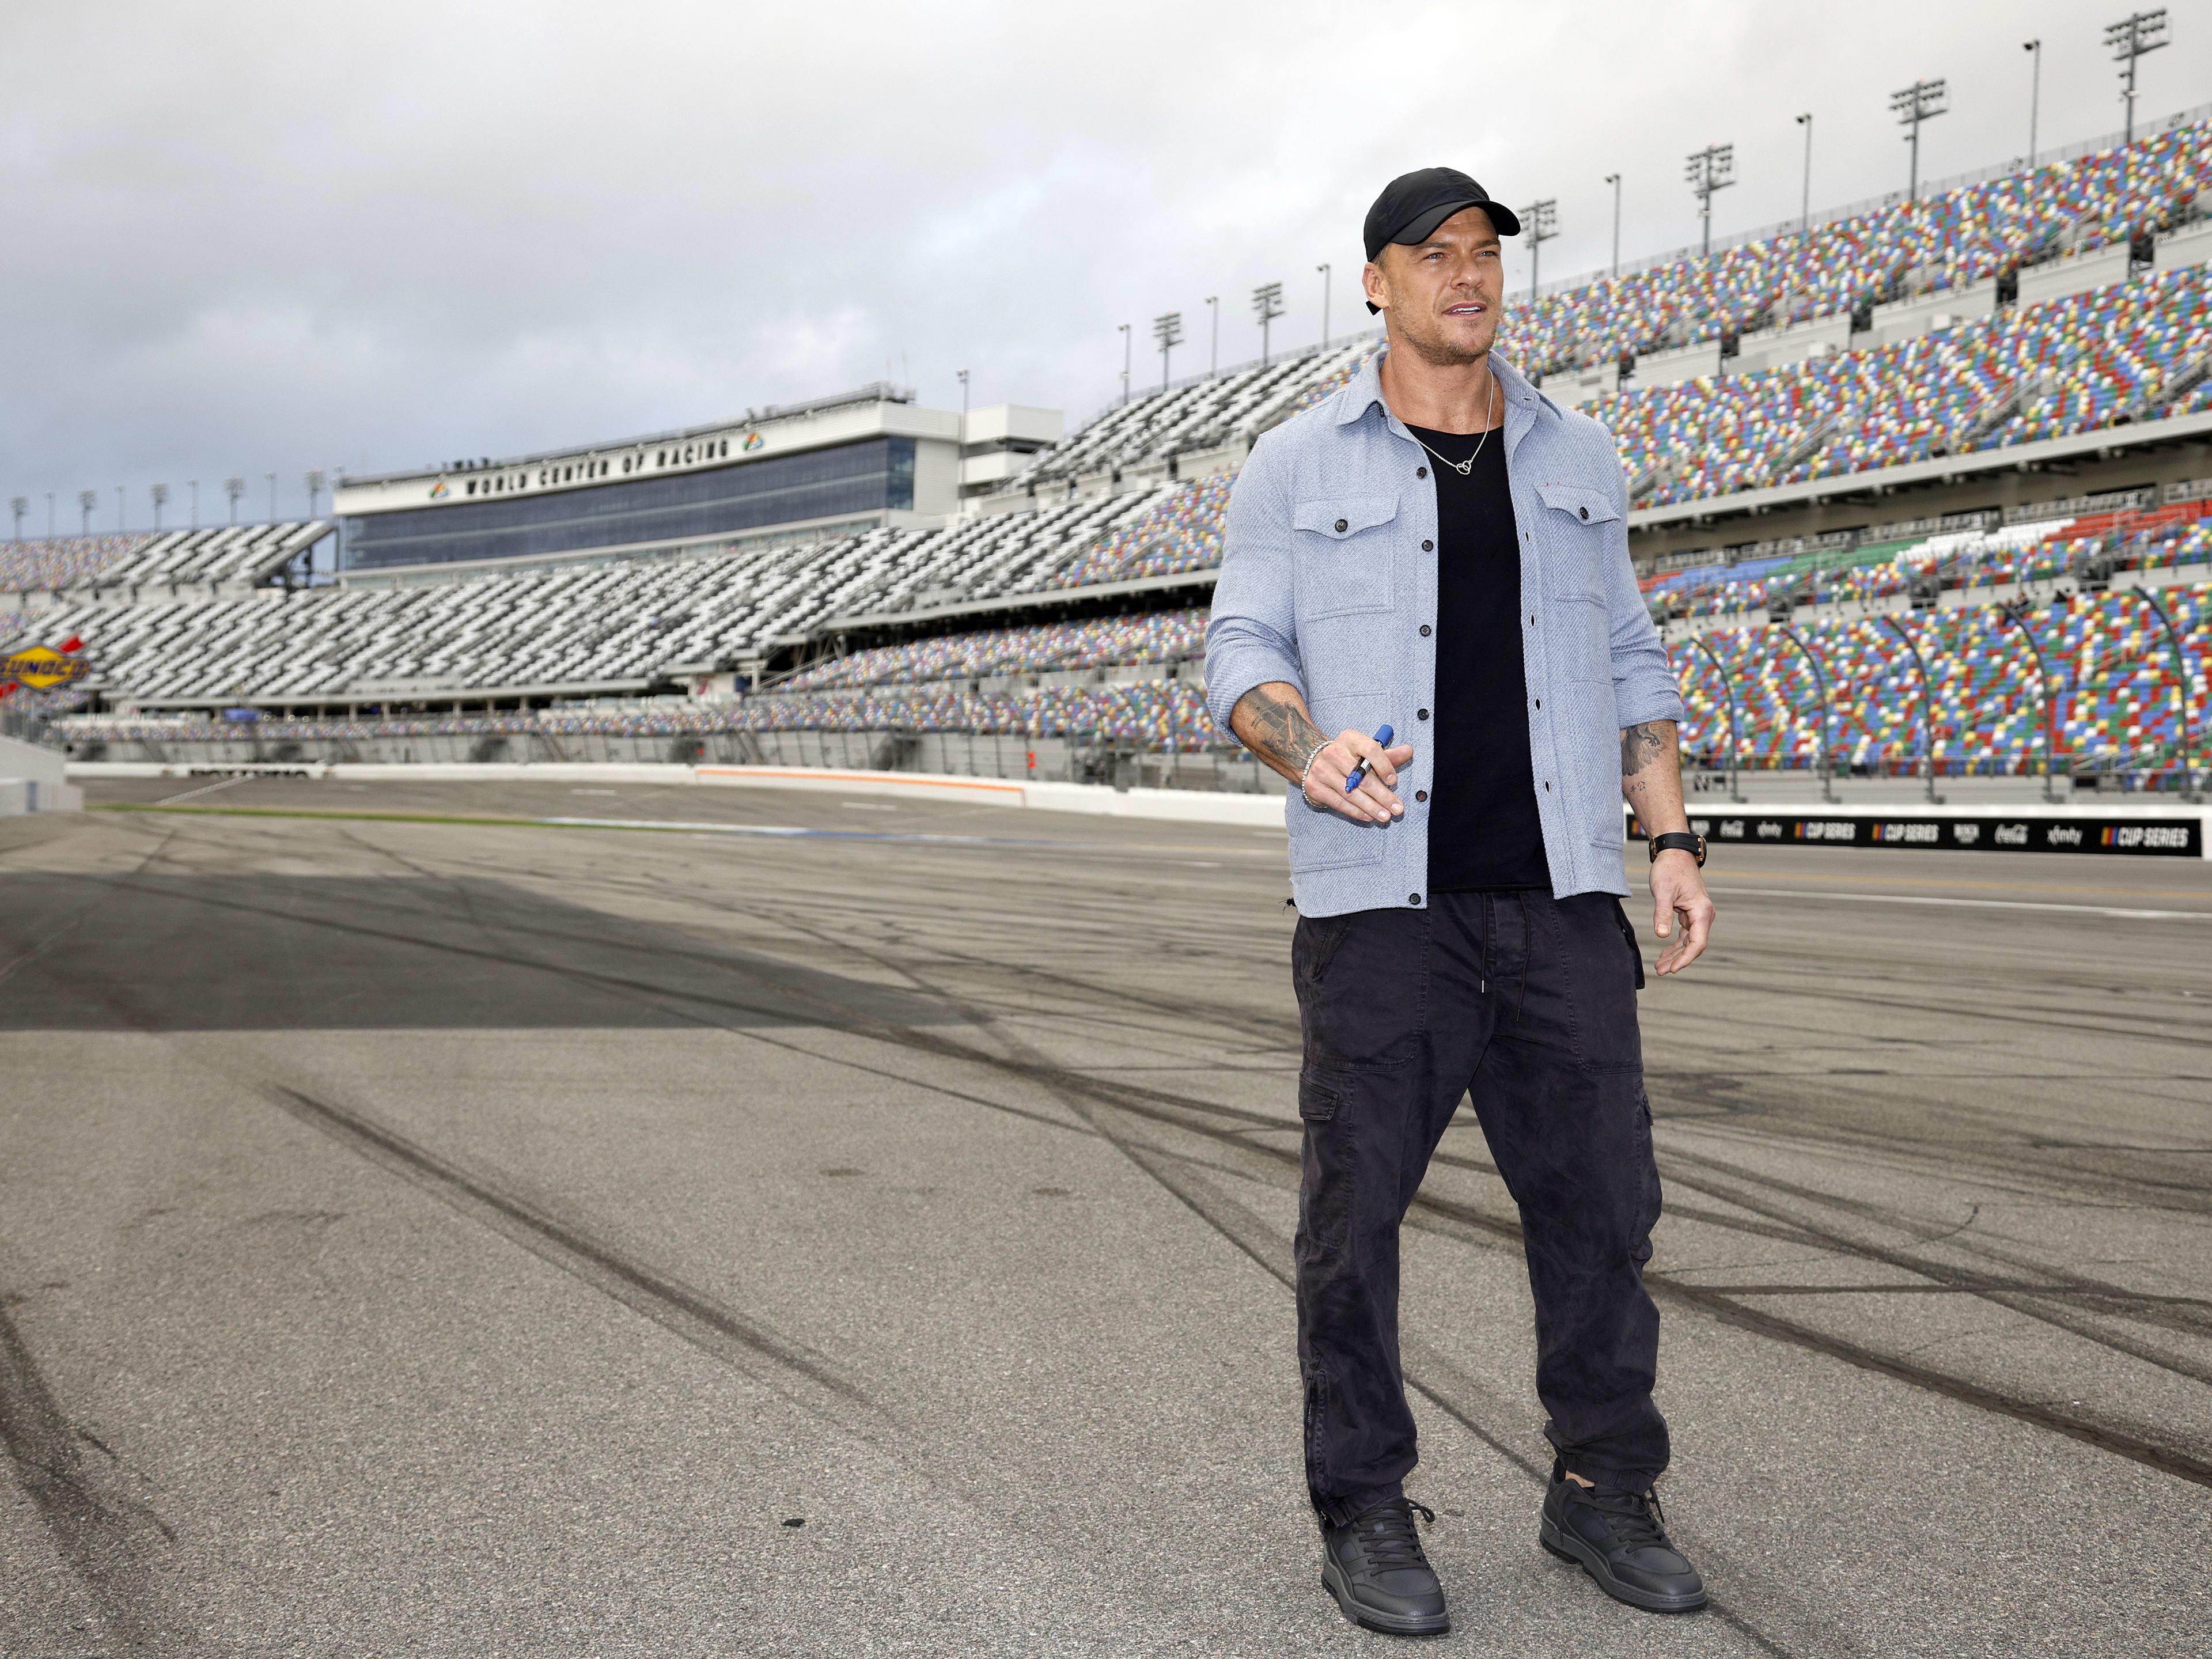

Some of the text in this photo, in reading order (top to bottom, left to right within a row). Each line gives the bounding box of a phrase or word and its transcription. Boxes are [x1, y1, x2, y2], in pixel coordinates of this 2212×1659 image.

[467, 440, 728, 494] WORLD CENTER OF RACING
[0, 658, 86, 675] SUNOCO
[1885, 824, 1904, 842] CUP
[1904, 824, 1940, 842] SERIES
[2118, 827, 2188, 848] CUP SERIES
